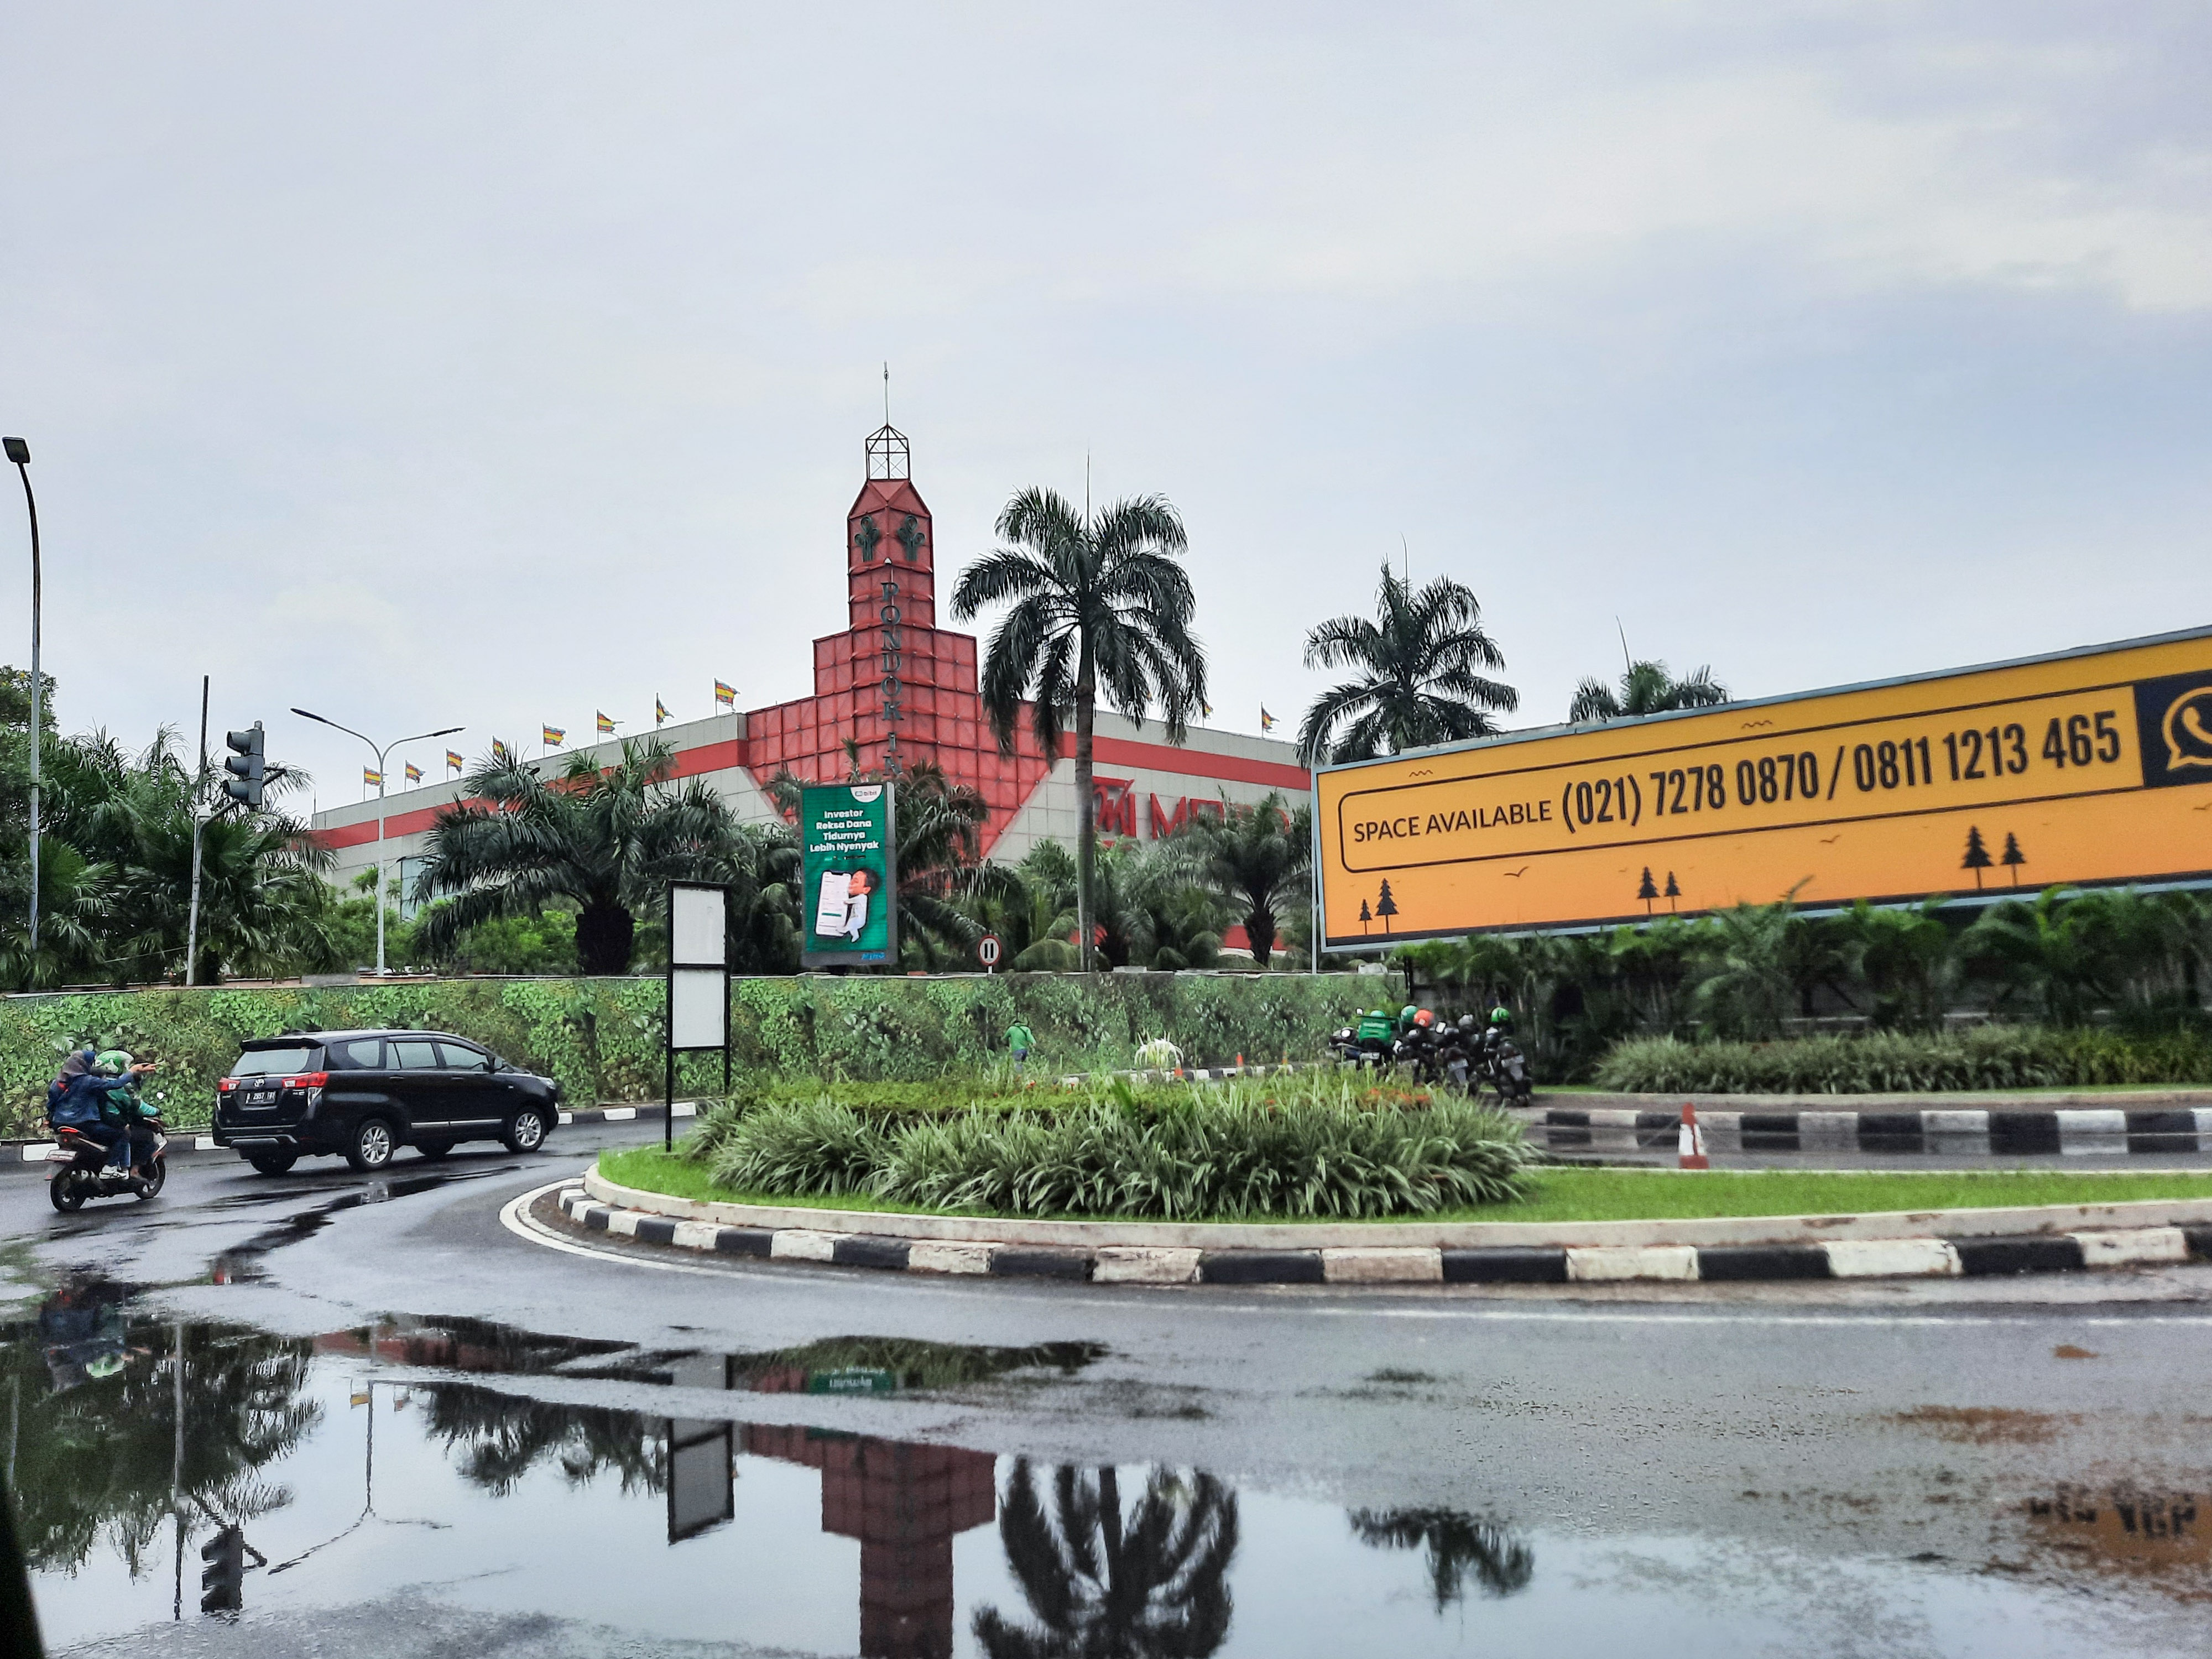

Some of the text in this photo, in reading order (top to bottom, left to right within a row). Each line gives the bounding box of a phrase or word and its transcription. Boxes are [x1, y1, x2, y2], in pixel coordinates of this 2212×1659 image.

[880, 582, 904, 721] PONDOK
[1354, 710, 2121, 842] SPACE AVAILABLE (021) 7278 0870 / 0811 1213 465
[824, 809, 864, 818] Investor
[816, 820, 872, 830] Reksa Dana
[823, 831, 865, 841] Tidurnya
[810, 840, 879, 853] Lebih Nyenyak
